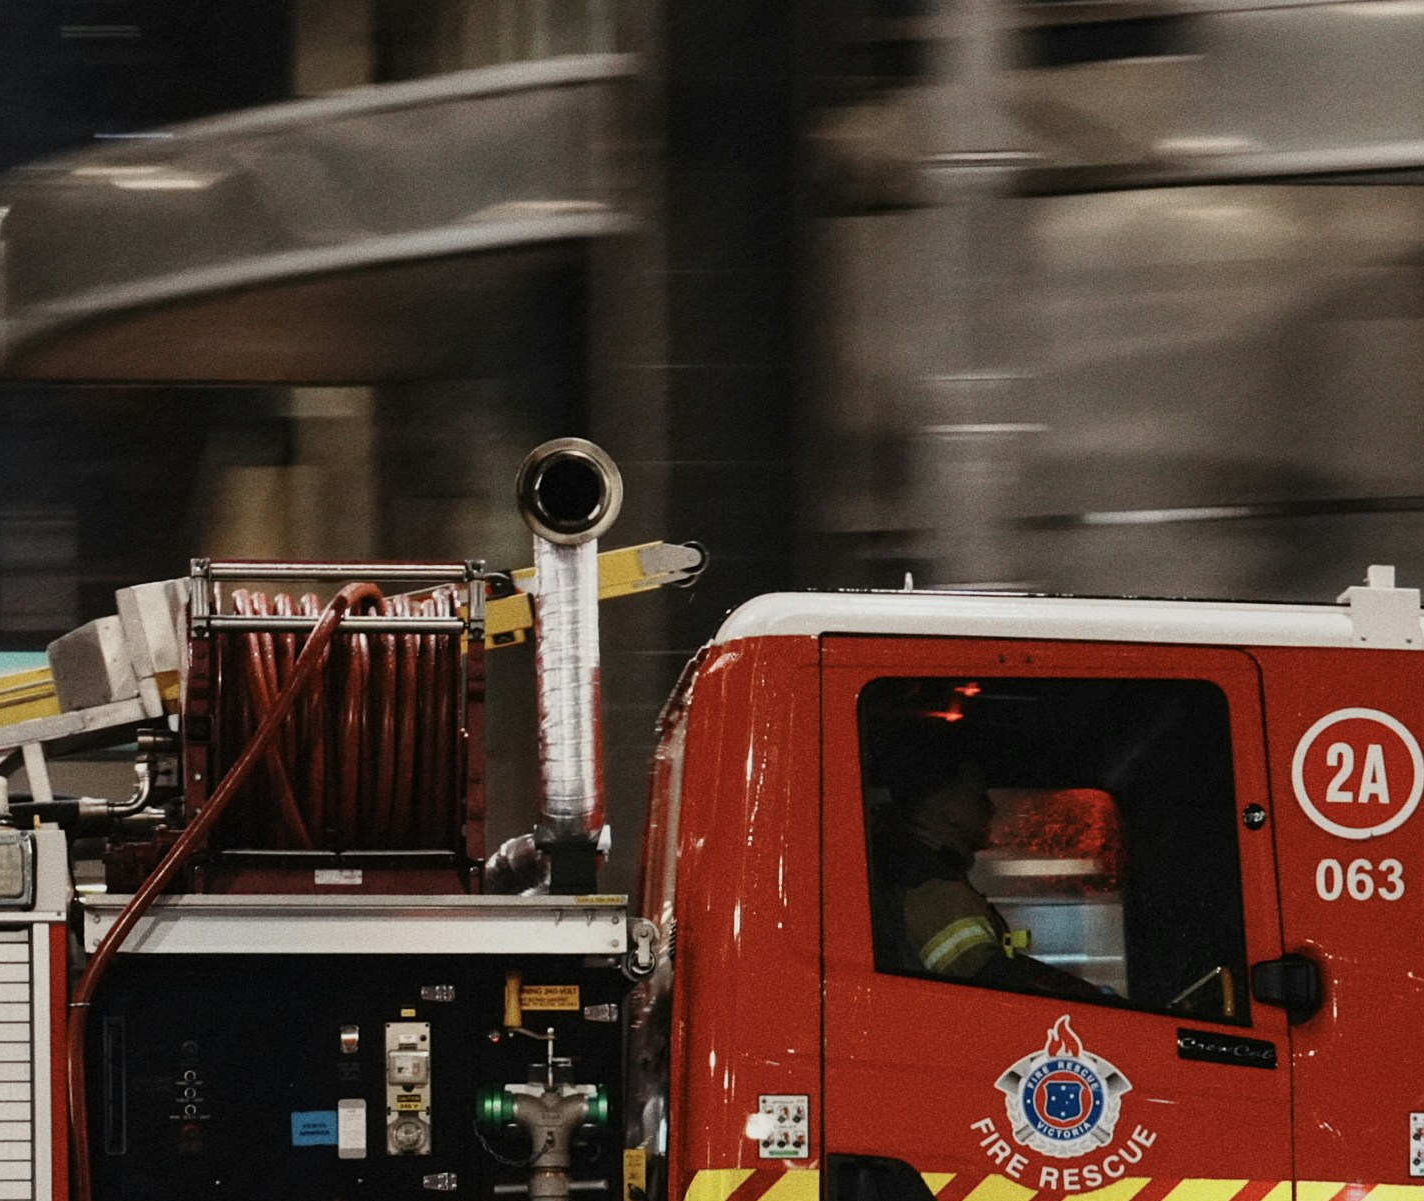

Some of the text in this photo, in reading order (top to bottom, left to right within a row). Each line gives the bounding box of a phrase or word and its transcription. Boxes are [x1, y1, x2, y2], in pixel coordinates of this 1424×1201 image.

[1325, 741, 1390, 804] 2A
[1315, 858, 1405, 901] 063
[1028, 1061, 1100, 1090] FIRE RESCUE
[1037, 1121, 1092, 1139] VICTORIA
[970, 1117, 1158, 1191] FIRE RESCUE
